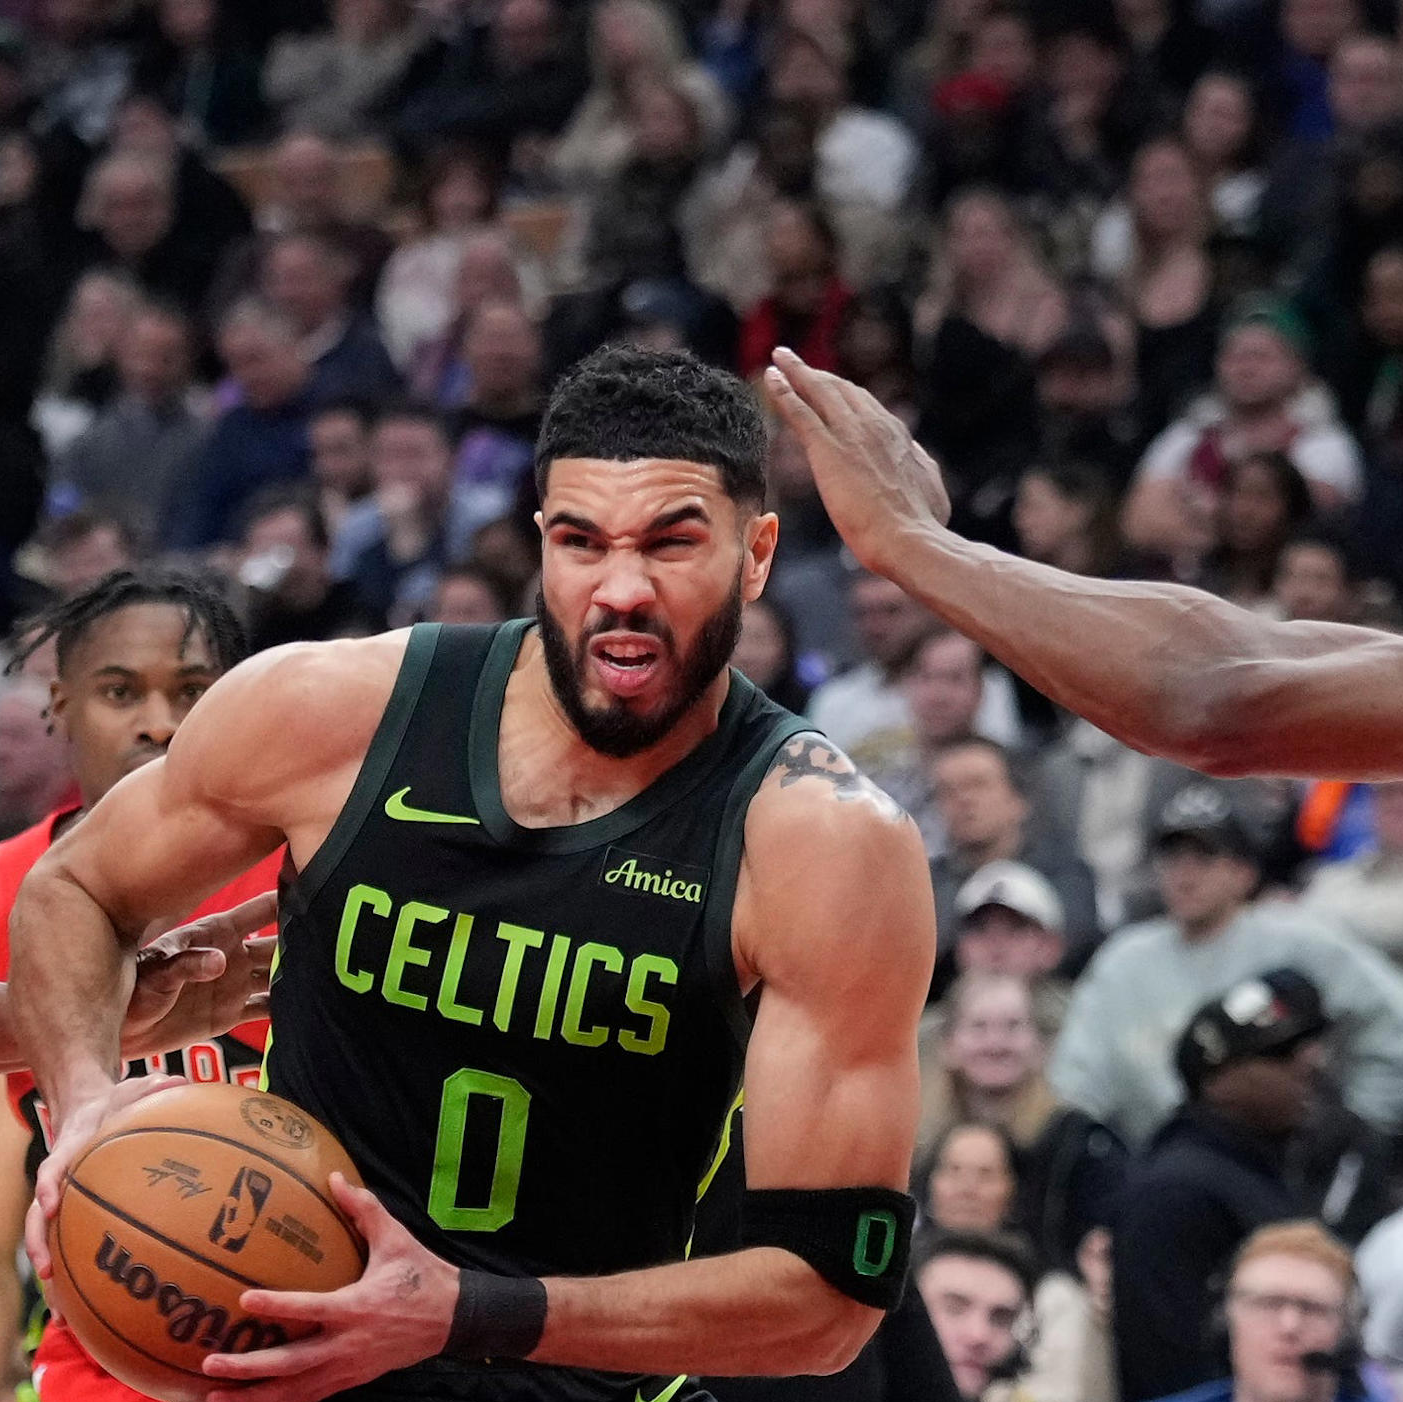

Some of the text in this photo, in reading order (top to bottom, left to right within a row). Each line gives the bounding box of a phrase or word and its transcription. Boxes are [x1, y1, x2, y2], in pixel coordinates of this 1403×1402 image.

[605, 859, 702, 903] Amica
[335, 884, 679, 1056] CELTICS
[427, 1067, 532, 1232] 0
[853, 1209, 897, 1277] 0
